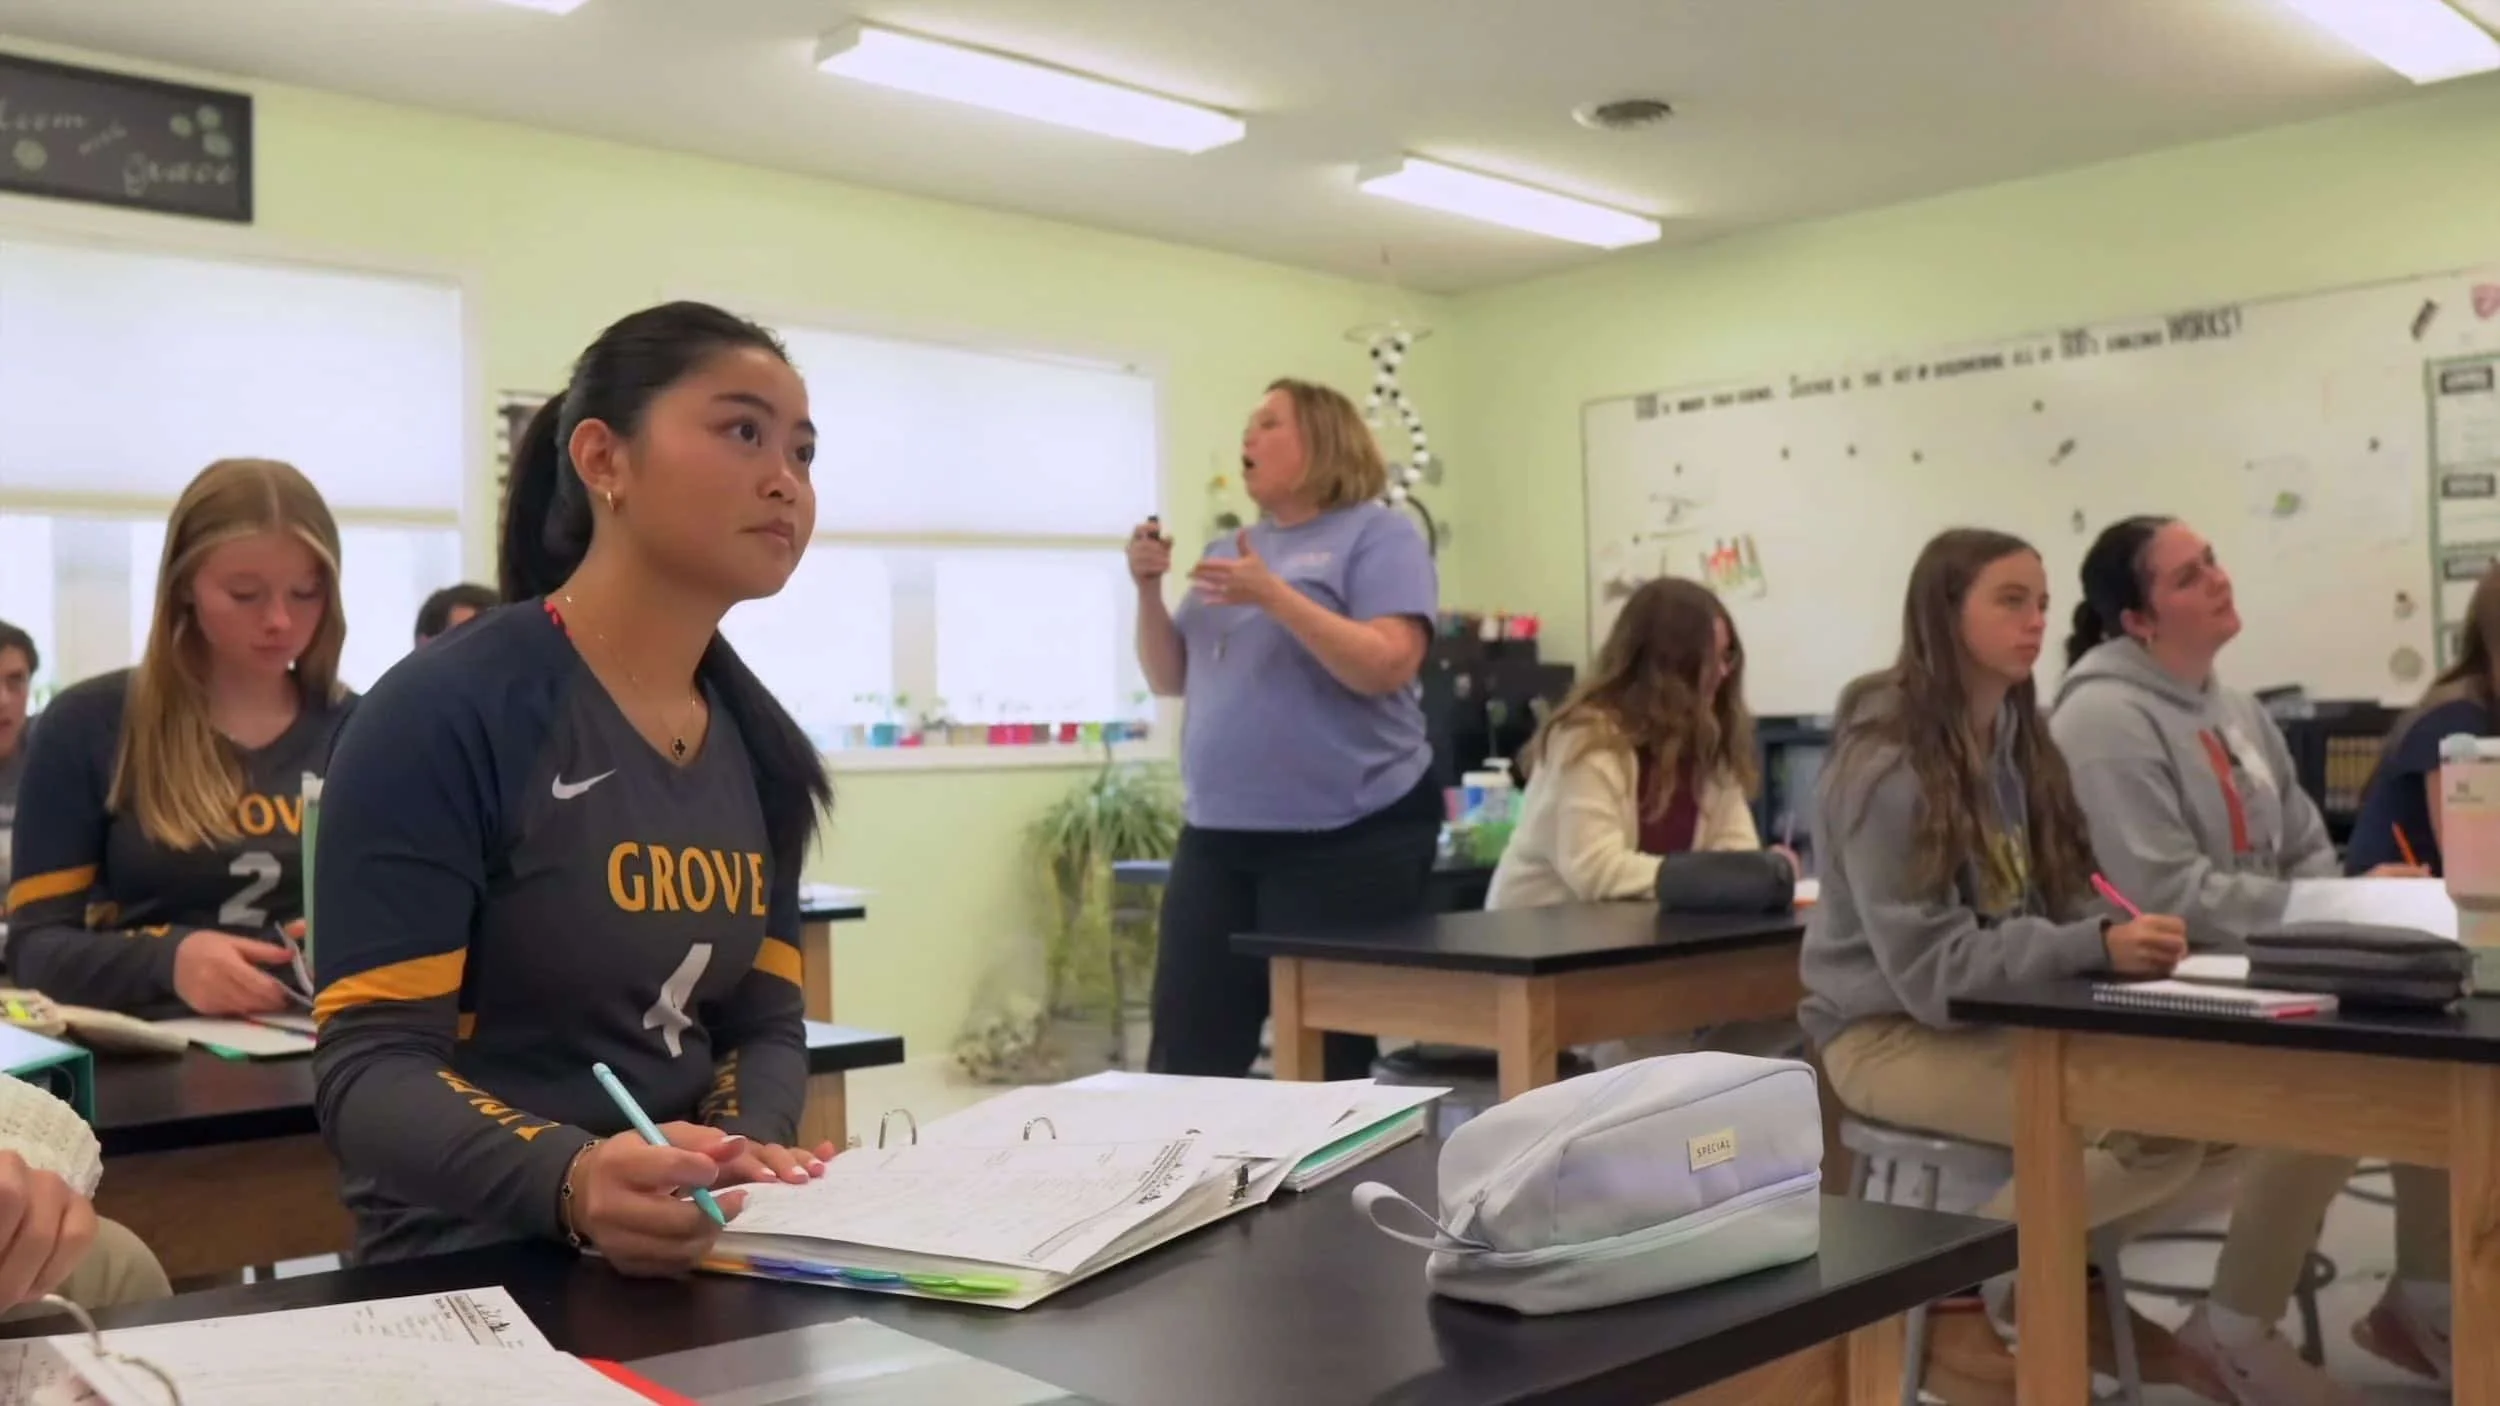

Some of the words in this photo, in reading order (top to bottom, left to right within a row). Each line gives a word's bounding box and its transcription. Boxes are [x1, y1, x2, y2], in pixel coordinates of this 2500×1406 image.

[218, 851, 282, 929] 2
[607, 841, 767, 917] GROVE
[643, 943, 713, 1058] 4
[1696, 1139, 1731, 1159] SPECIAL
